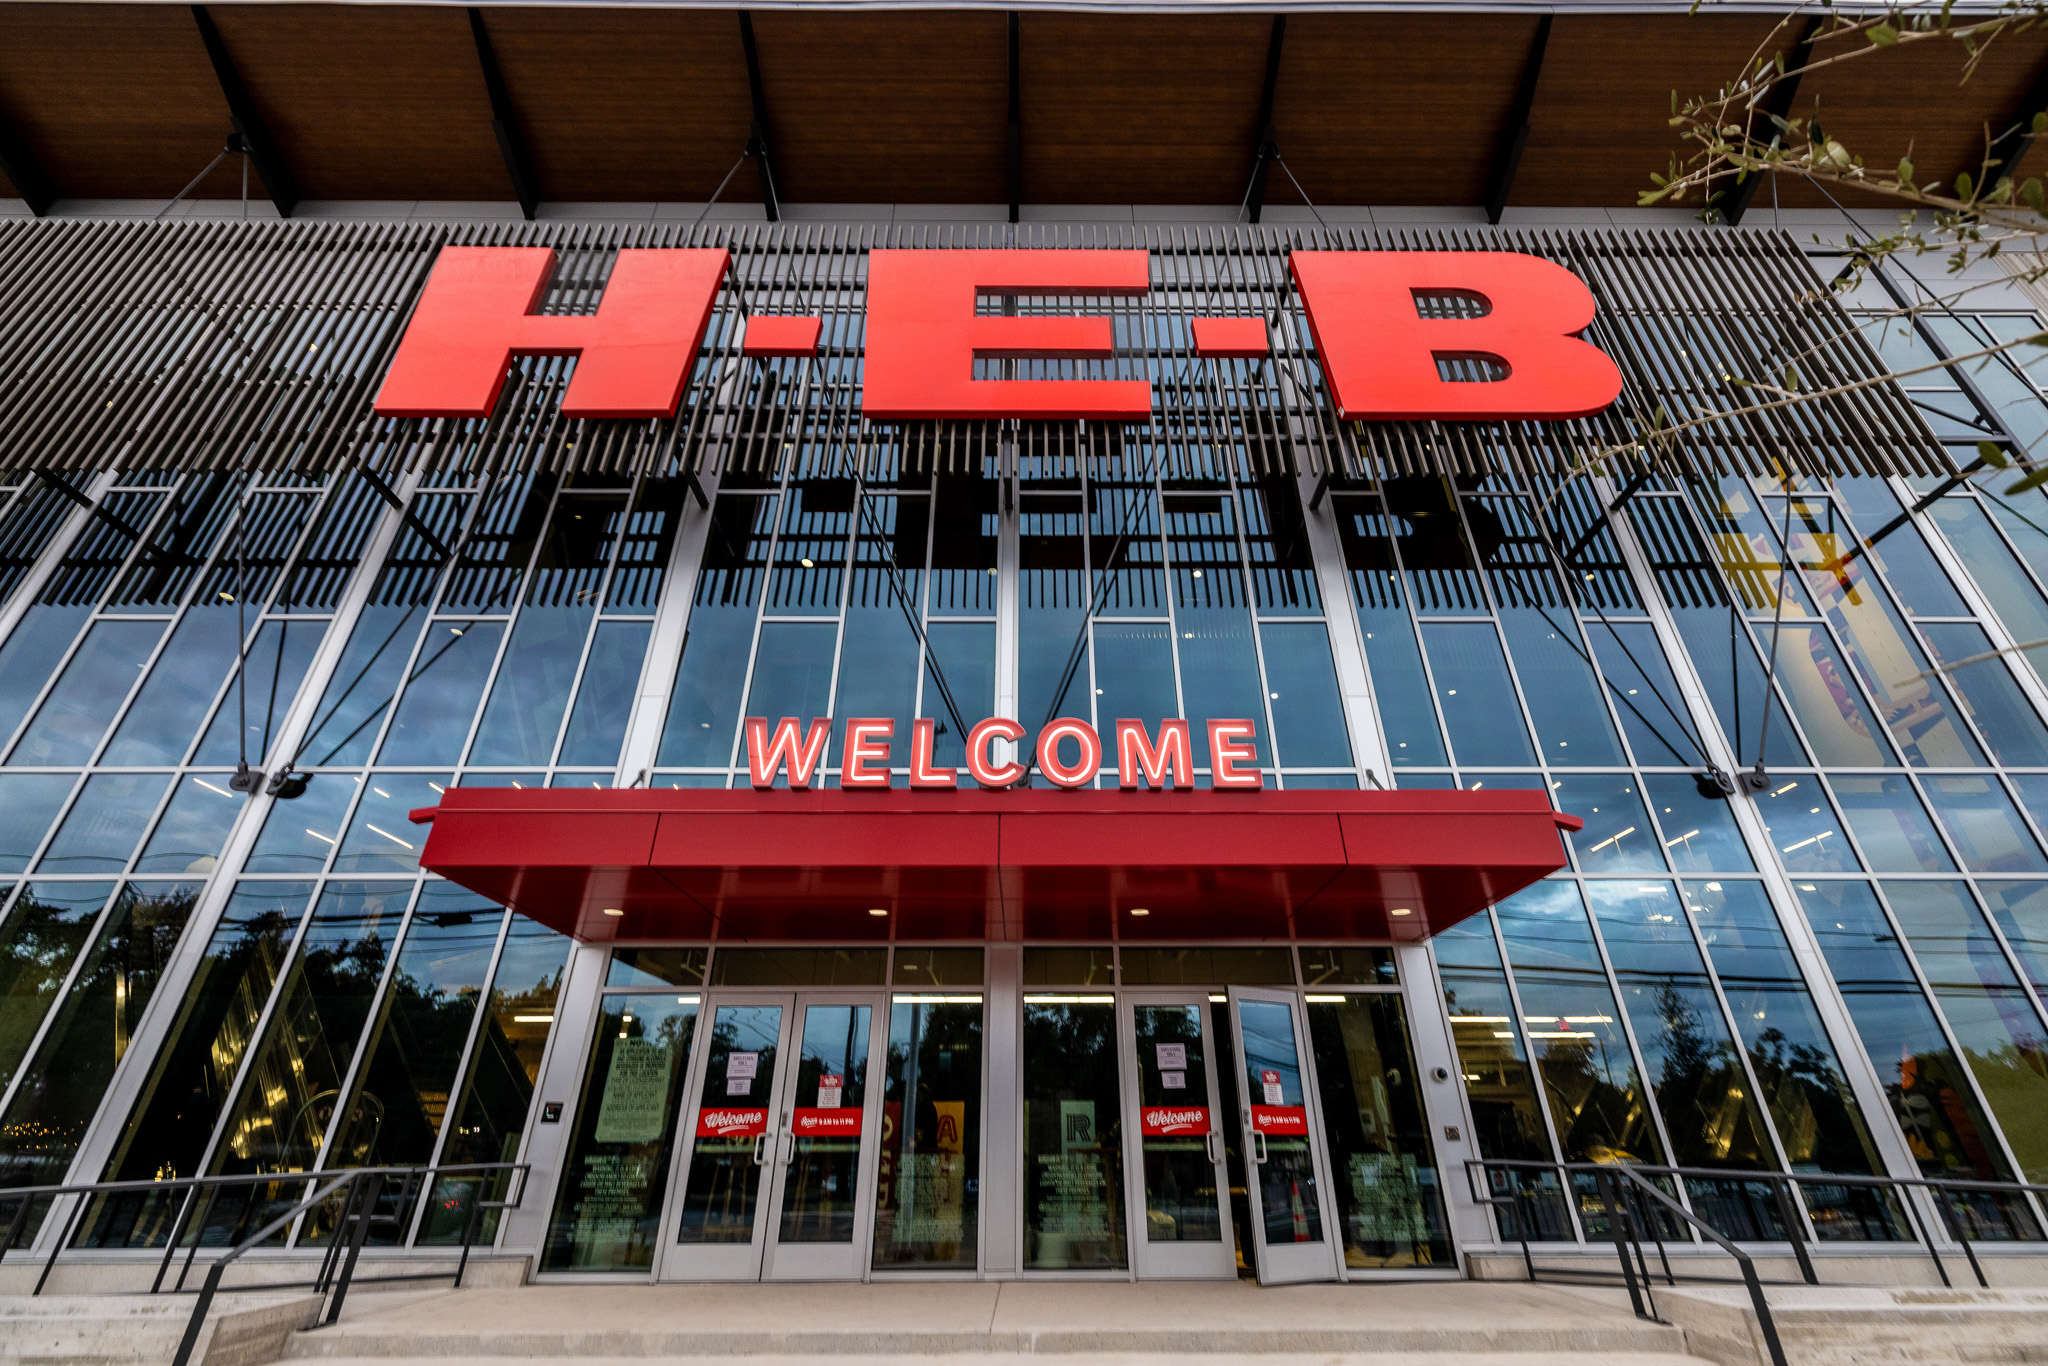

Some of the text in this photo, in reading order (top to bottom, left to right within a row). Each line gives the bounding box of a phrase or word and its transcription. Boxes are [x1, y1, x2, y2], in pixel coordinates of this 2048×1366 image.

[373, 246, 1623, 420] H-E-B
[745, 717, 1263, 789] WELCOME
[705, 1111, 762, 1130] Welcome
[823, 1118, 832, 1126] AM
[845, 1118, 854, 1126] PM
[1147, 1110, 1203, 1128] Welcome
